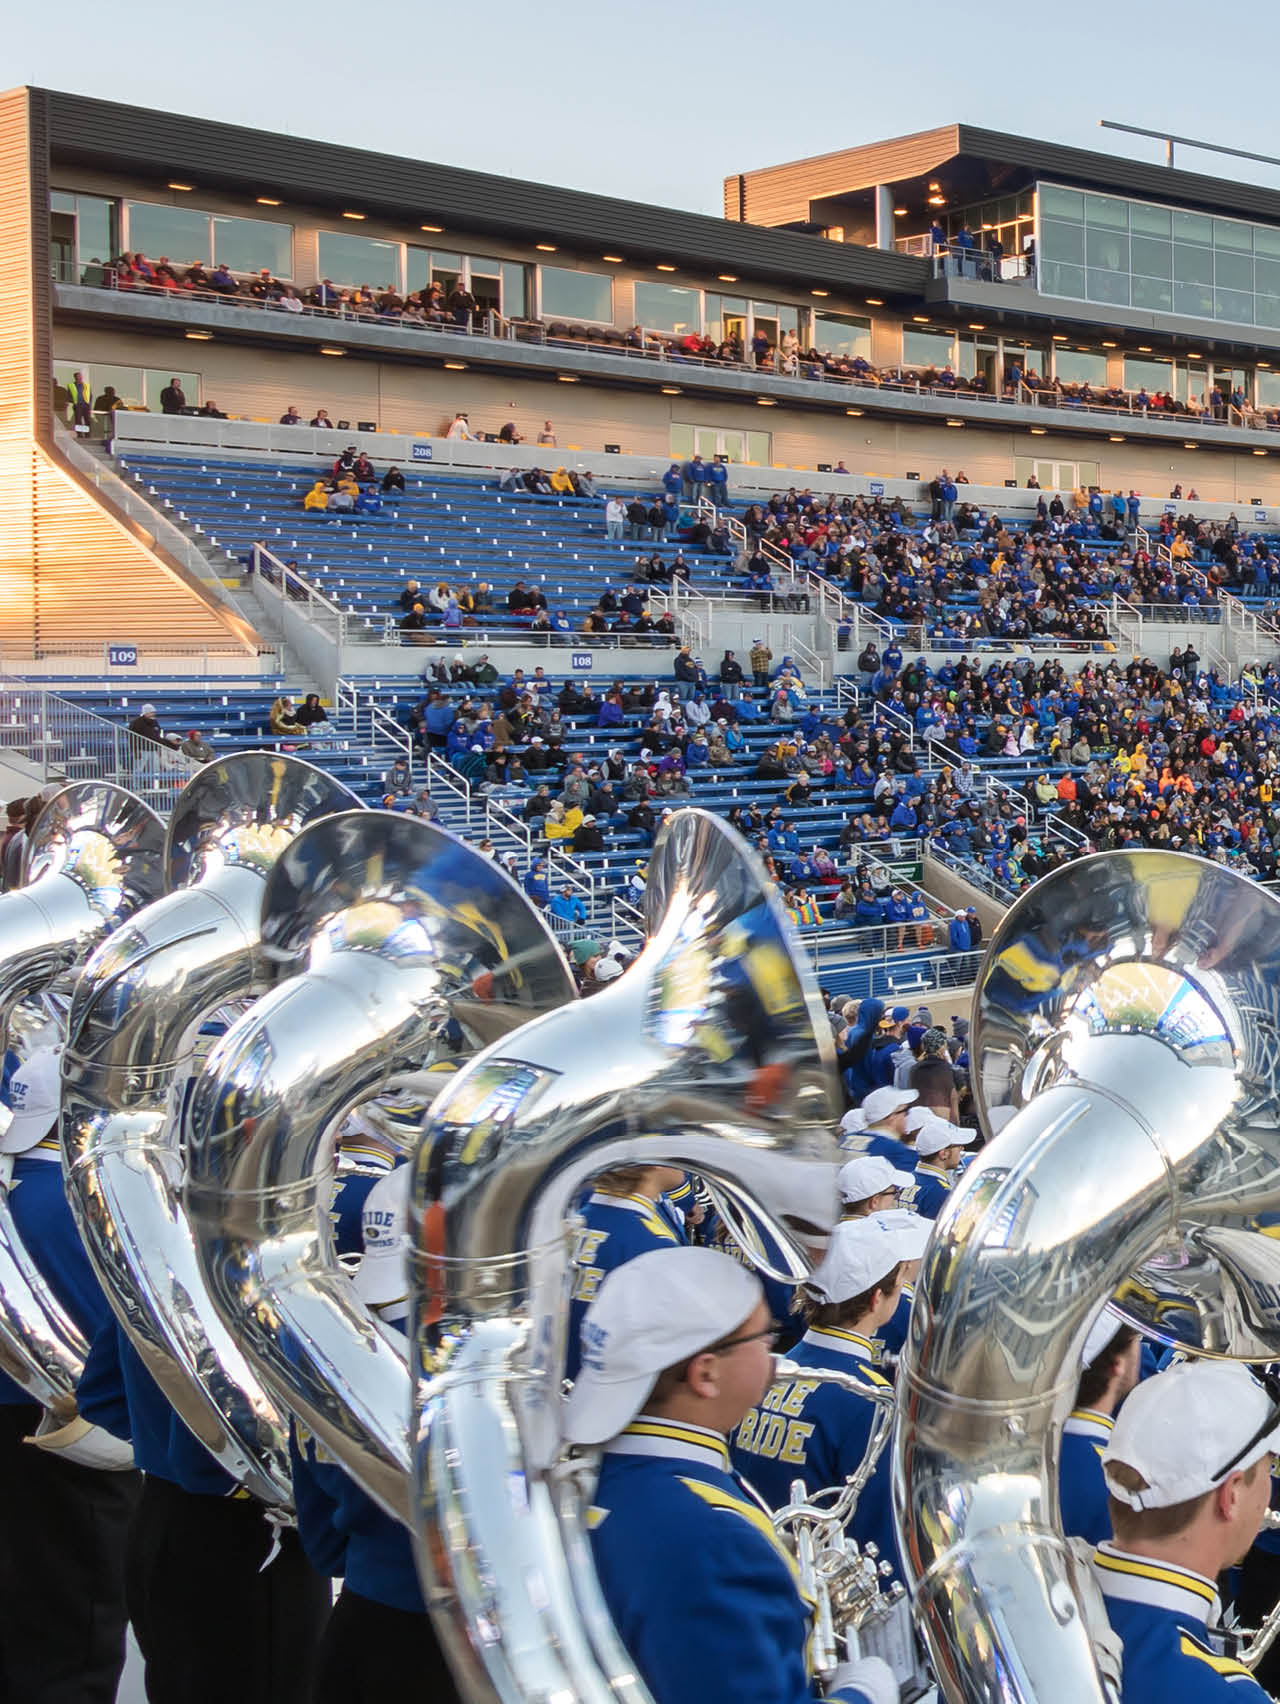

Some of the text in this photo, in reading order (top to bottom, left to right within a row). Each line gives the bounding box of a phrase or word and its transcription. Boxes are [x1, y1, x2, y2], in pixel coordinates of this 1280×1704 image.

[110, 651, 136, 663] 109
[573, 656, 592, 667] 108
[762, 1379, 822, 1418] HE
[736, 1408, 817, 1465] RIDE
